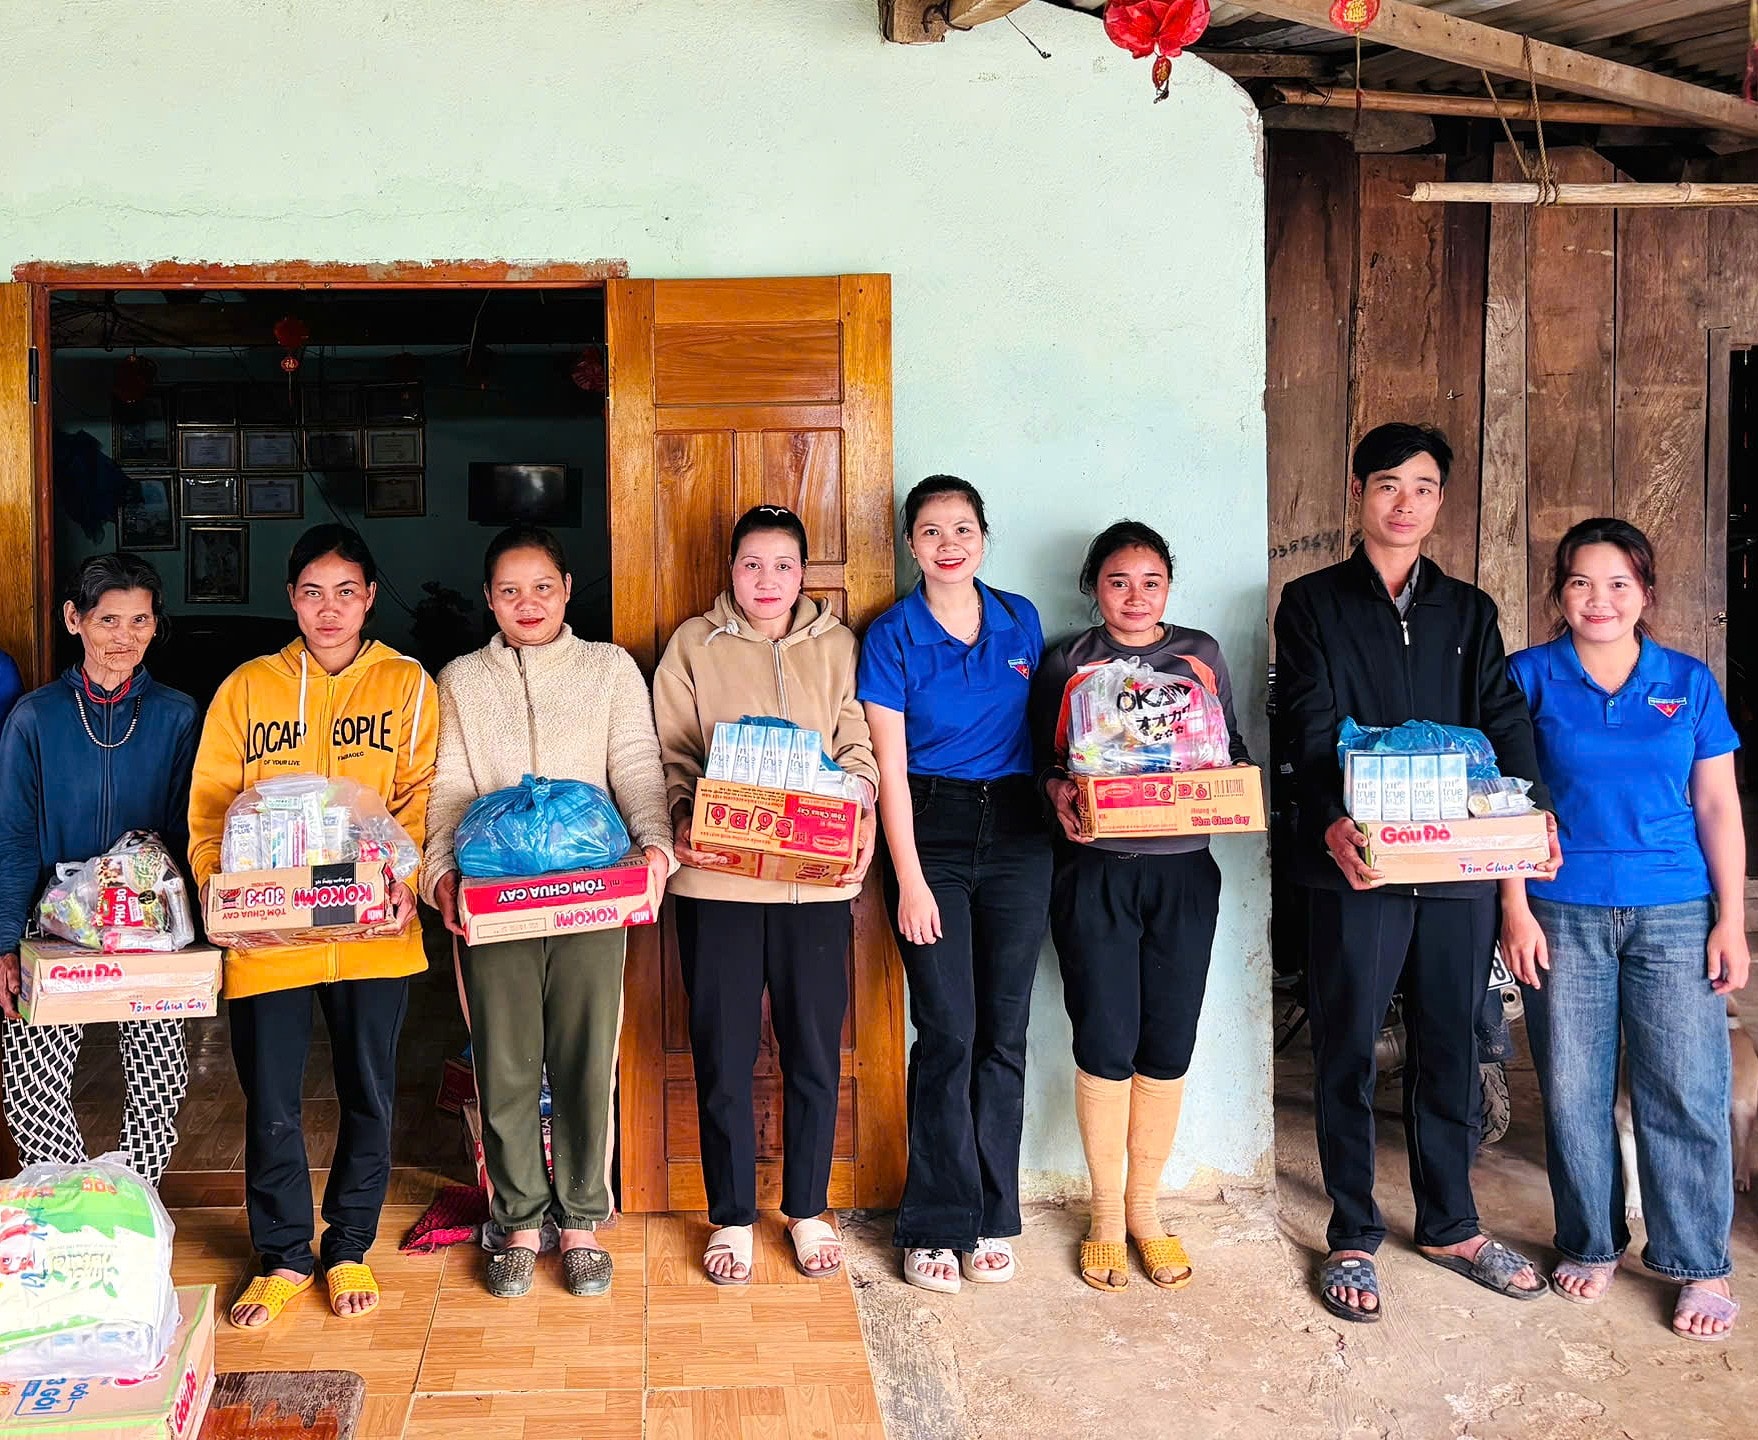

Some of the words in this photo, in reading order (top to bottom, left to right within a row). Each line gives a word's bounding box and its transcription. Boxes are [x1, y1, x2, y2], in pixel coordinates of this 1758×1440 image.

[332, 710, 394, 753] EOPLE
[1356, 790, 1376, 798] true
[1385, 790, 1406, 798] true
[1414, 790, 1434, 798] true
[1443, 788, 1463, 796] true
[1380, 825, 1421, 844] Gấu
[1423, 824, 1451, 843] Đỏ
[1460, 863, 1482, 873] Tôm
[1485, 862, 1514, 873] Chua
[1517, 860, 1538, 872] Cay
[528, 882, 571, 898] CHUA
[572, 878, 606, 895] TÔM
[245, 886, 285, 908] 30+3
[293, 884, 373, 908] KOKOMI
[497, 888, 527, 903] CAY
[222, 911, 240, 921] CAY
[241, 909, 266, 919] CHUA
[267, 907, 286, 918] TÔM
[555, 906, 618, 929] KOKOMI
[129, 1001, 151, 1013] Tôm
[155, 998, 183, 1013] Chua
[187, 998, 208, 1011] Cay
[32, 1388, 61, 1410] GÓI
